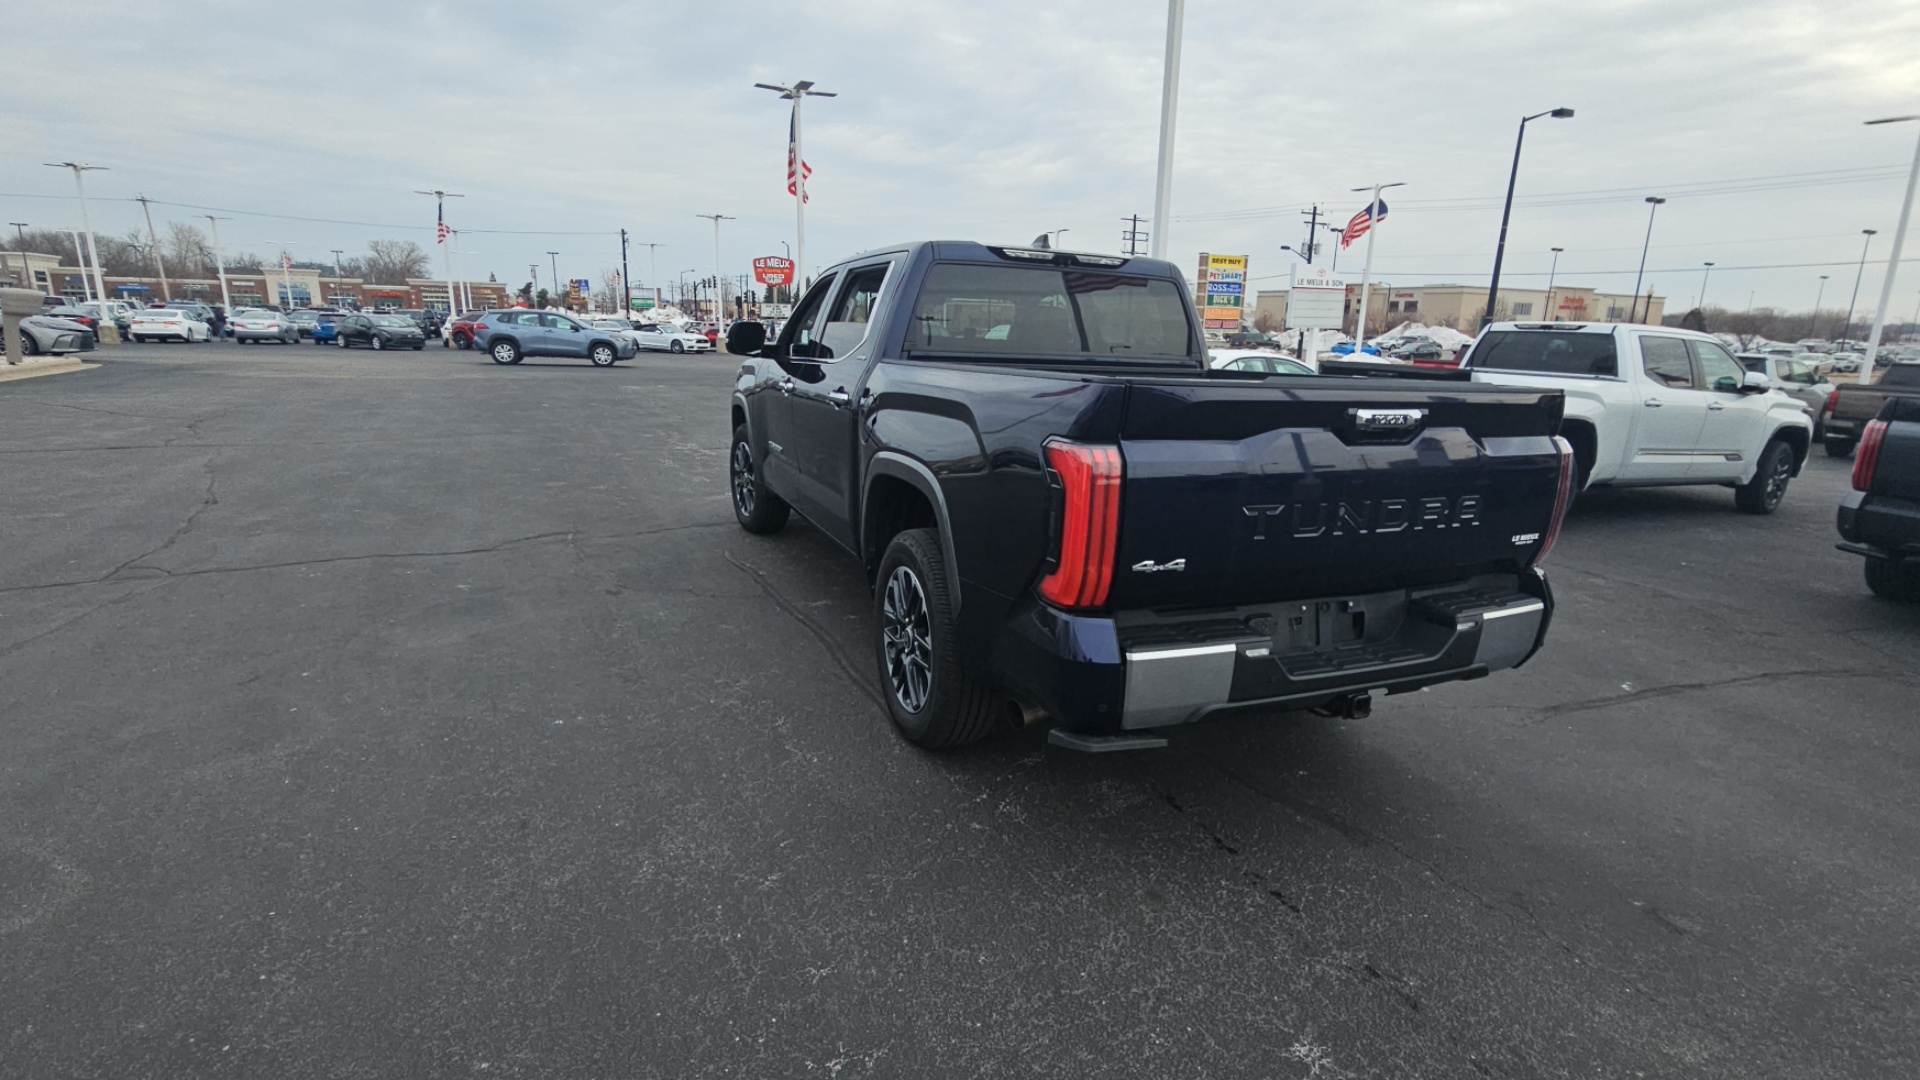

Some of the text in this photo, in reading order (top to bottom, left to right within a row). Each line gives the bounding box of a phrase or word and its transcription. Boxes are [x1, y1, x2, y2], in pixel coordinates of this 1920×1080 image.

[756, 259, 764, 267] LE
[1297, 278, 1305, 286] LE
[1331, 279, 1344, 287] SON
[1375, 415, 1405, 425] TOYOTA
[1242, 494, 1481, 540] TUNDRA
